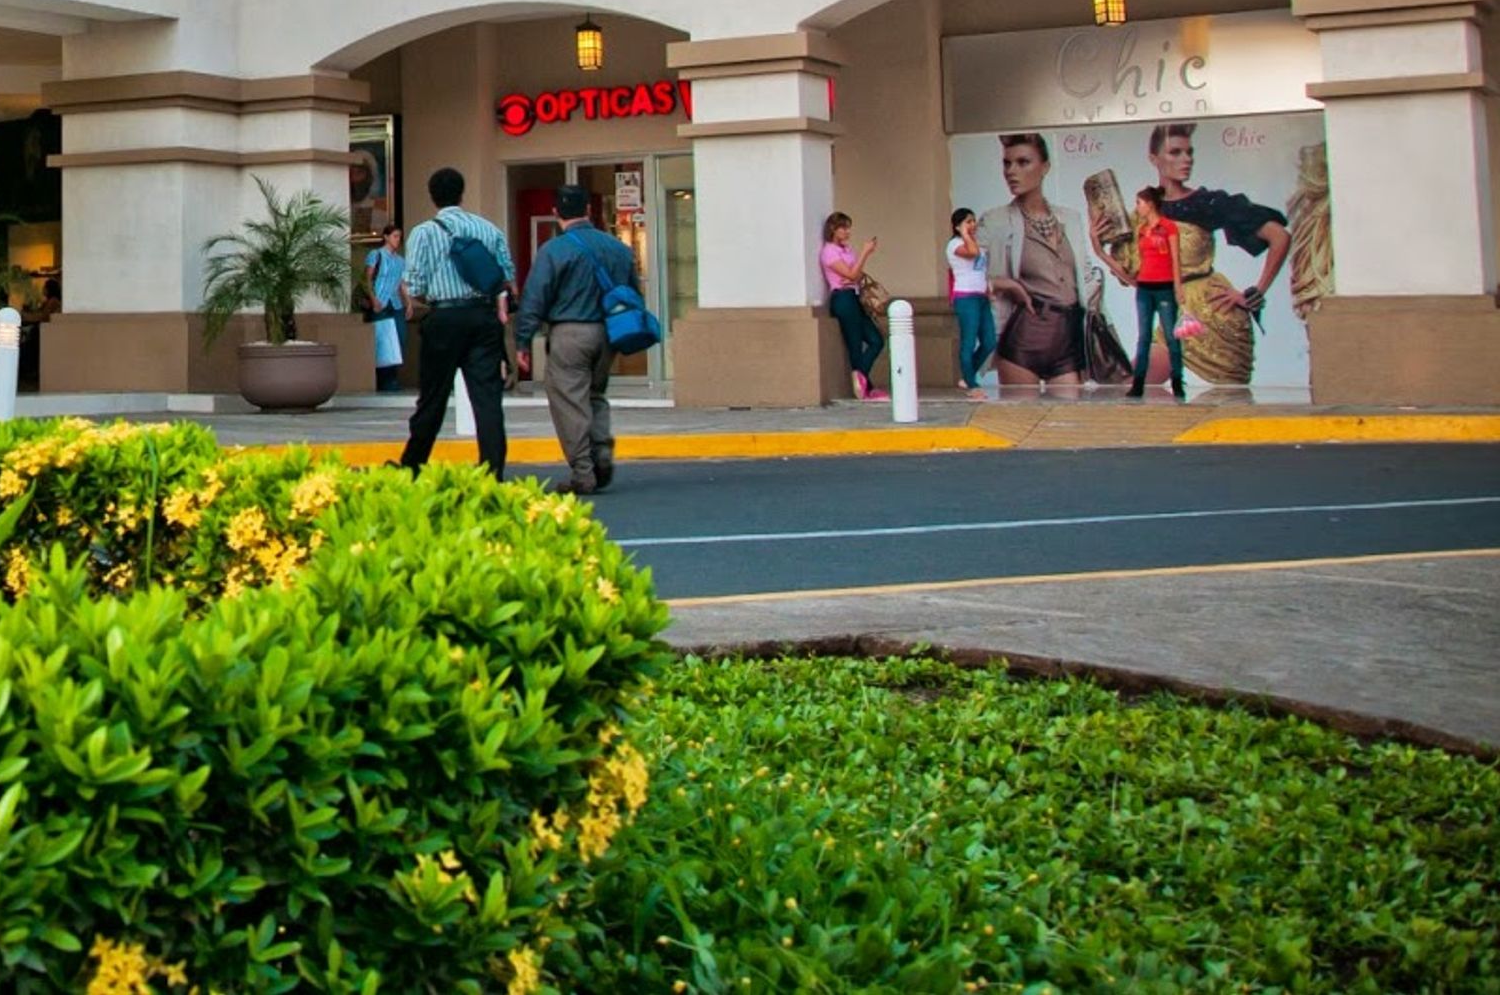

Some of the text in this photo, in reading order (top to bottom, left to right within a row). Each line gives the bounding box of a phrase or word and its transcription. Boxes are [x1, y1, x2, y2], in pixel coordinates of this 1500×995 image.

[1056, 28, 1207, 99] Chic
[534, 80, 676, 125] OPTICAS
[1062, 98, 1208, 121] urban
[1063, 133, 1104, 155] Chic
[1221, 126, 1267, 148] Chic
